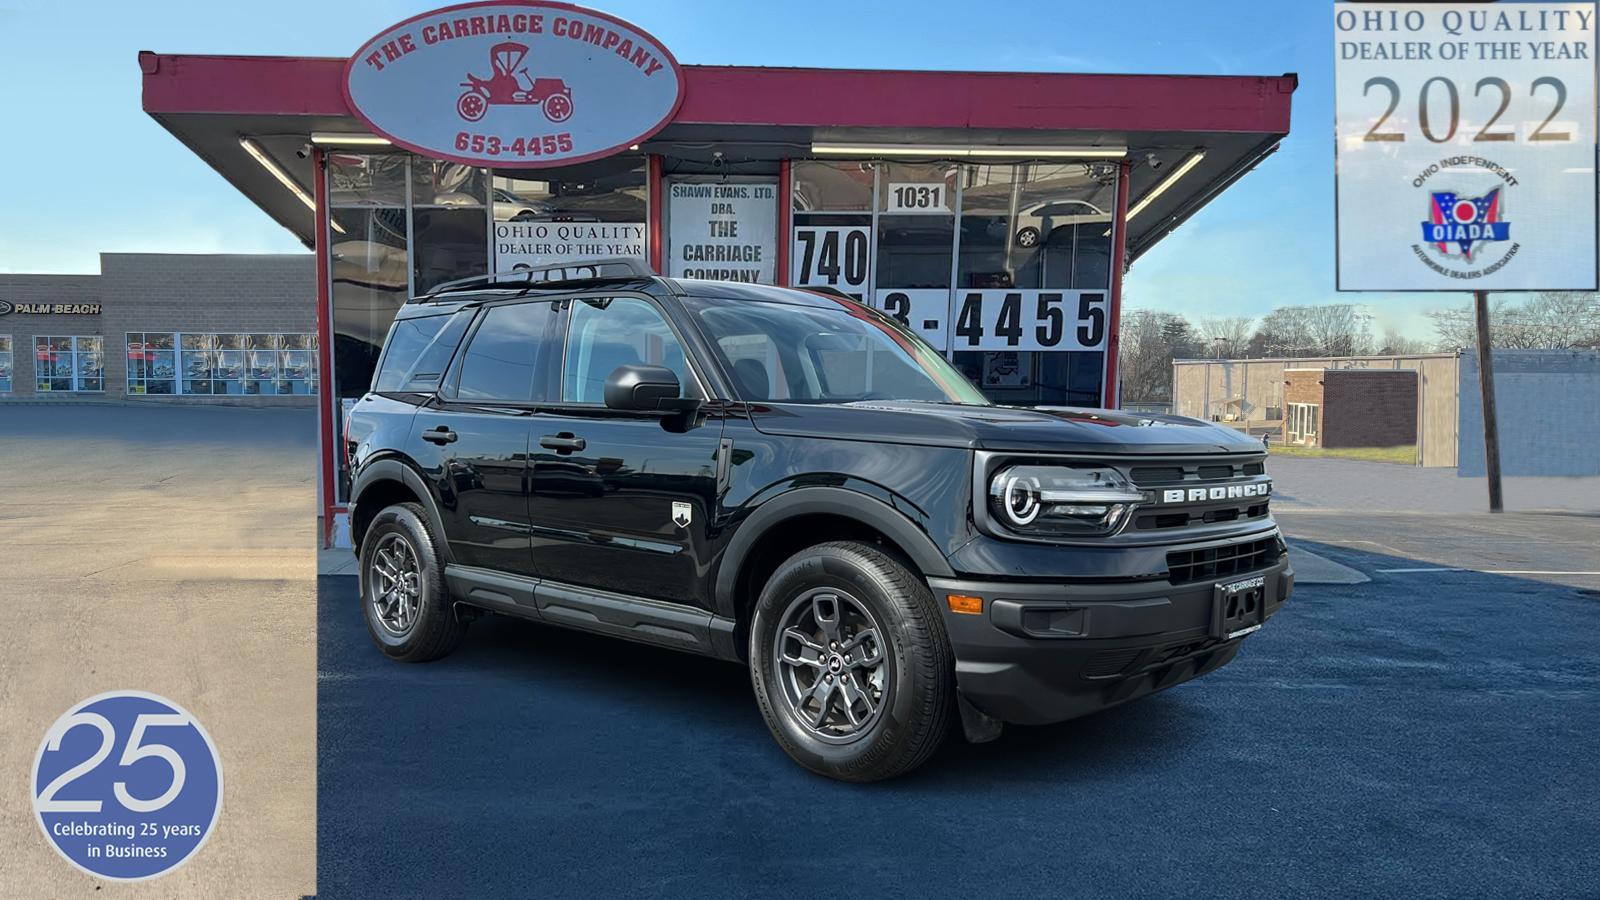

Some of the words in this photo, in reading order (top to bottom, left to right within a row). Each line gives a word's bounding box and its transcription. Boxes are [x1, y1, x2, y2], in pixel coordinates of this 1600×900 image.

[1336, 10, 1425, 32] OHIO
[1442, 10, 1593, 35] QUALITY
[366, 34, 416, 72] THE
[422, 14, 544, 45] CARRIAGE
[553, 17, 664, 77] COMPANY
[1340, 42, 1433, 60] DEALER
[1439, 42, 1469, 60] OF
[1475, 42, 1522, 60] THE
[1528, 42, 1589, 60] YEAR
[1363, 76, 1571, 143] 2022
[455, 132, 573, 156] 653-4455
[1412, 164, 1440, 188] OHIO
[1440, 155, 1519, 187] INDEPENDENT
[672, 186, 712, 199] SHAWN
[754, 187, 774, 199] LTD.
[895, 187, 940, 209] 1031
[711, 203, 736, 215] DBA.
[497, 226, 548, 238] OHIO
[557, 226, 644, 241] QUALITY
[708, 220, 738, 238] THE
[1433, 224, 1495, 240] OIADA
[499, 243, 551, 255] DEALER
[555, 243, 574, 255] OF
[576, 243, 603, 255] THE
[606, 243, 641, 255] YEAR
[683, 245, 762, 262] CARRIAGE
[797, 230, 868, 286] 740
[683, 268, 761, 283] COMPANY
[1450, 270, 1482, 280] DEALERS
[15, 304, 51, 314] PALM
[55, 304, 100, 314] BEACH
[1164, 483, 1268, 503] BRONCO
